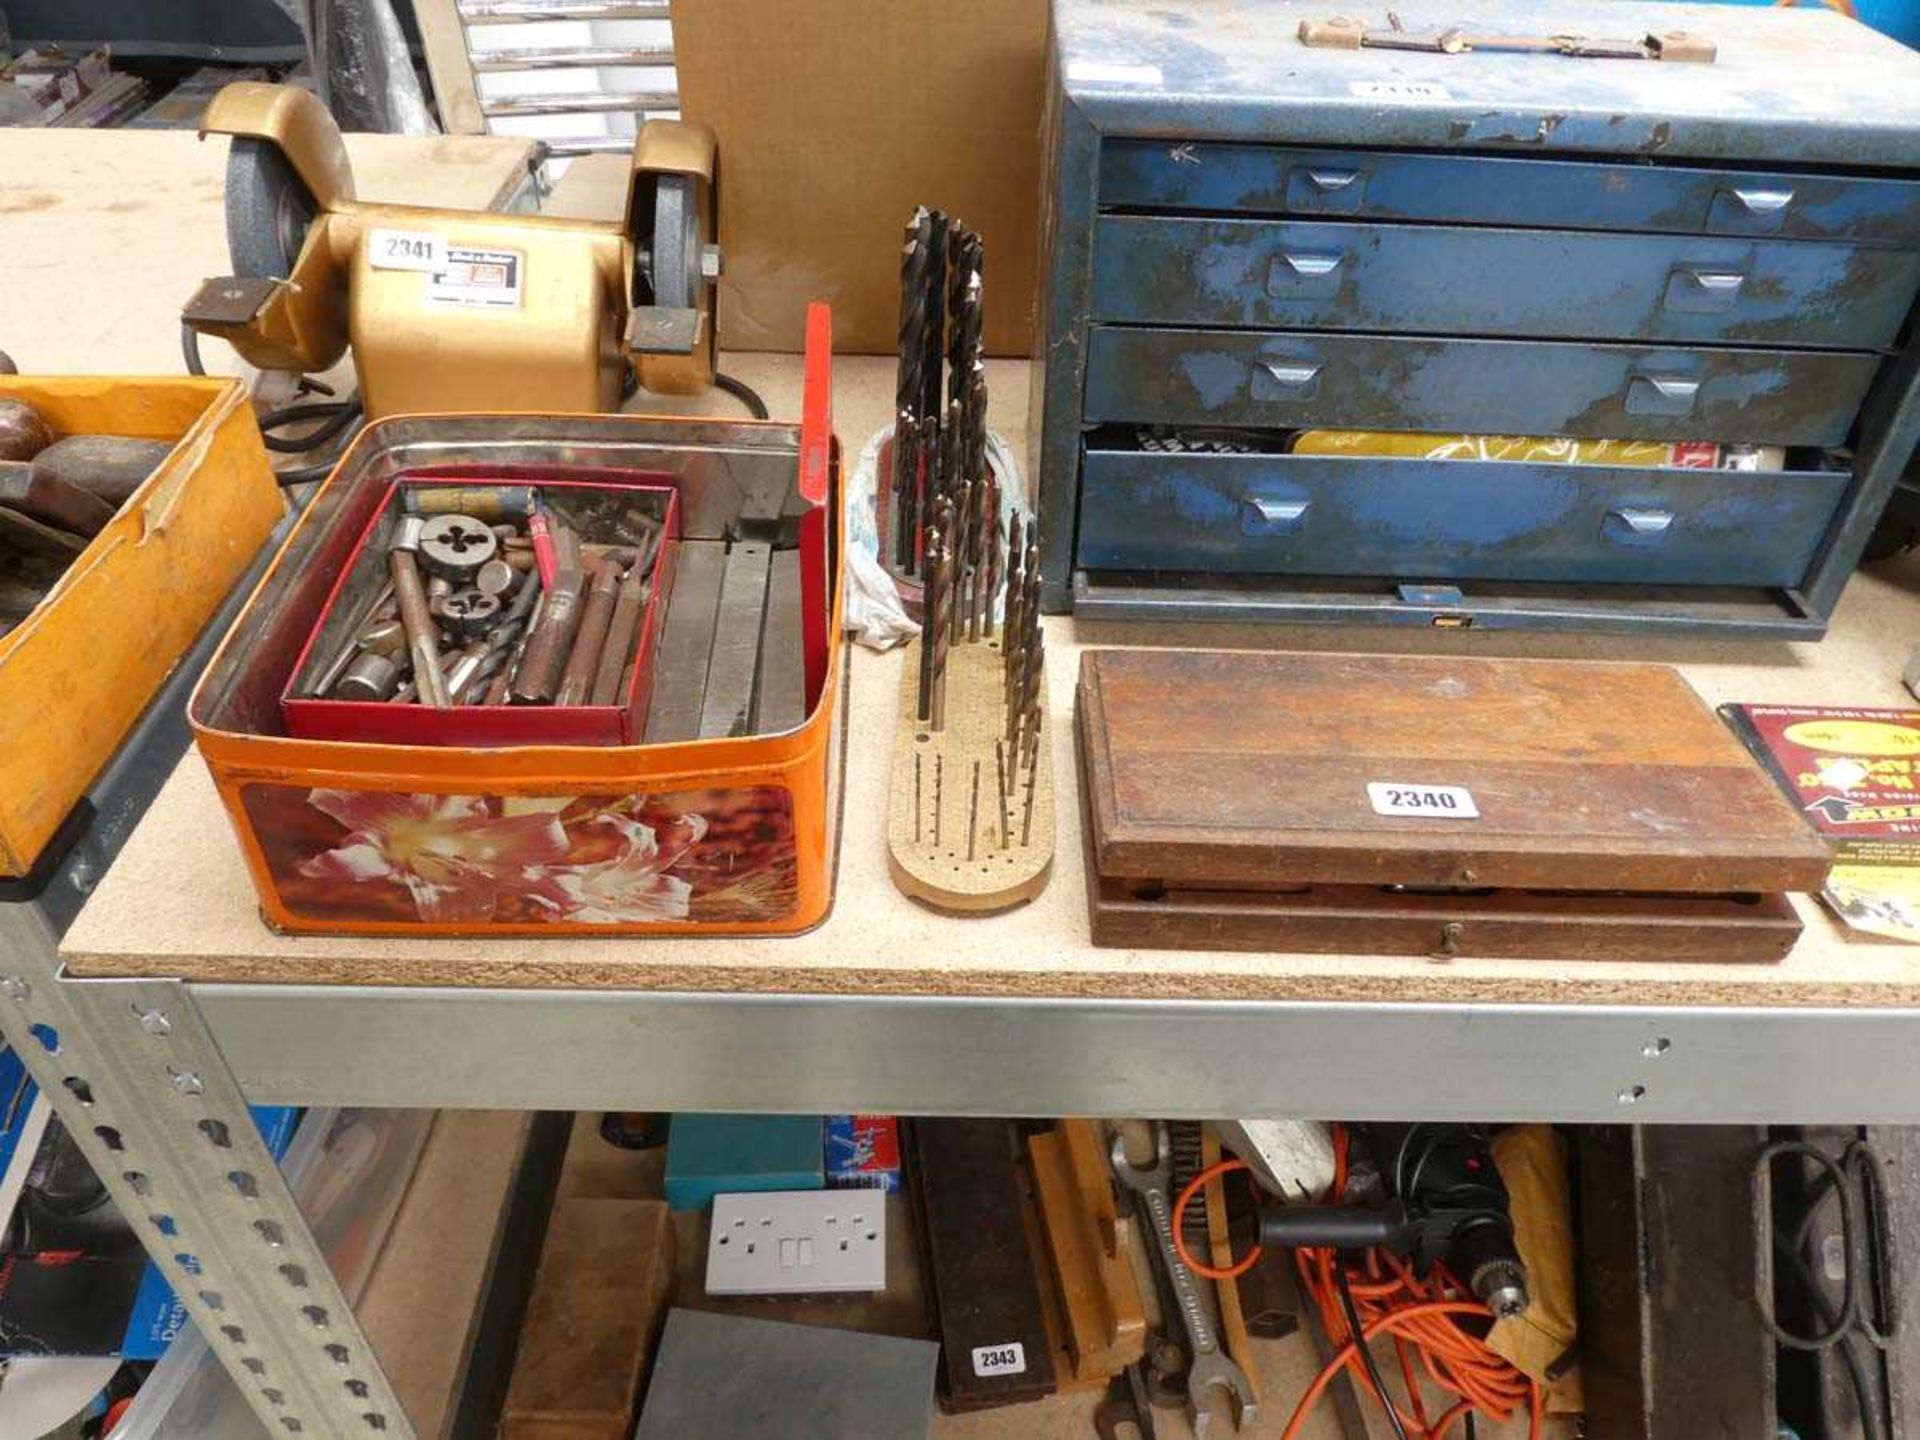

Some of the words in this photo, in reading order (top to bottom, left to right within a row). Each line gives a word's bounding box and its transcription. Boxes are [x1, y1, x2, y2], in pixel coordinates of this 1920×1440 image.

[386, 238, 433, 260] 2341
[1387, 790, 1456, 808] 2340
[981, 1349, 1017, 1367] 2343
